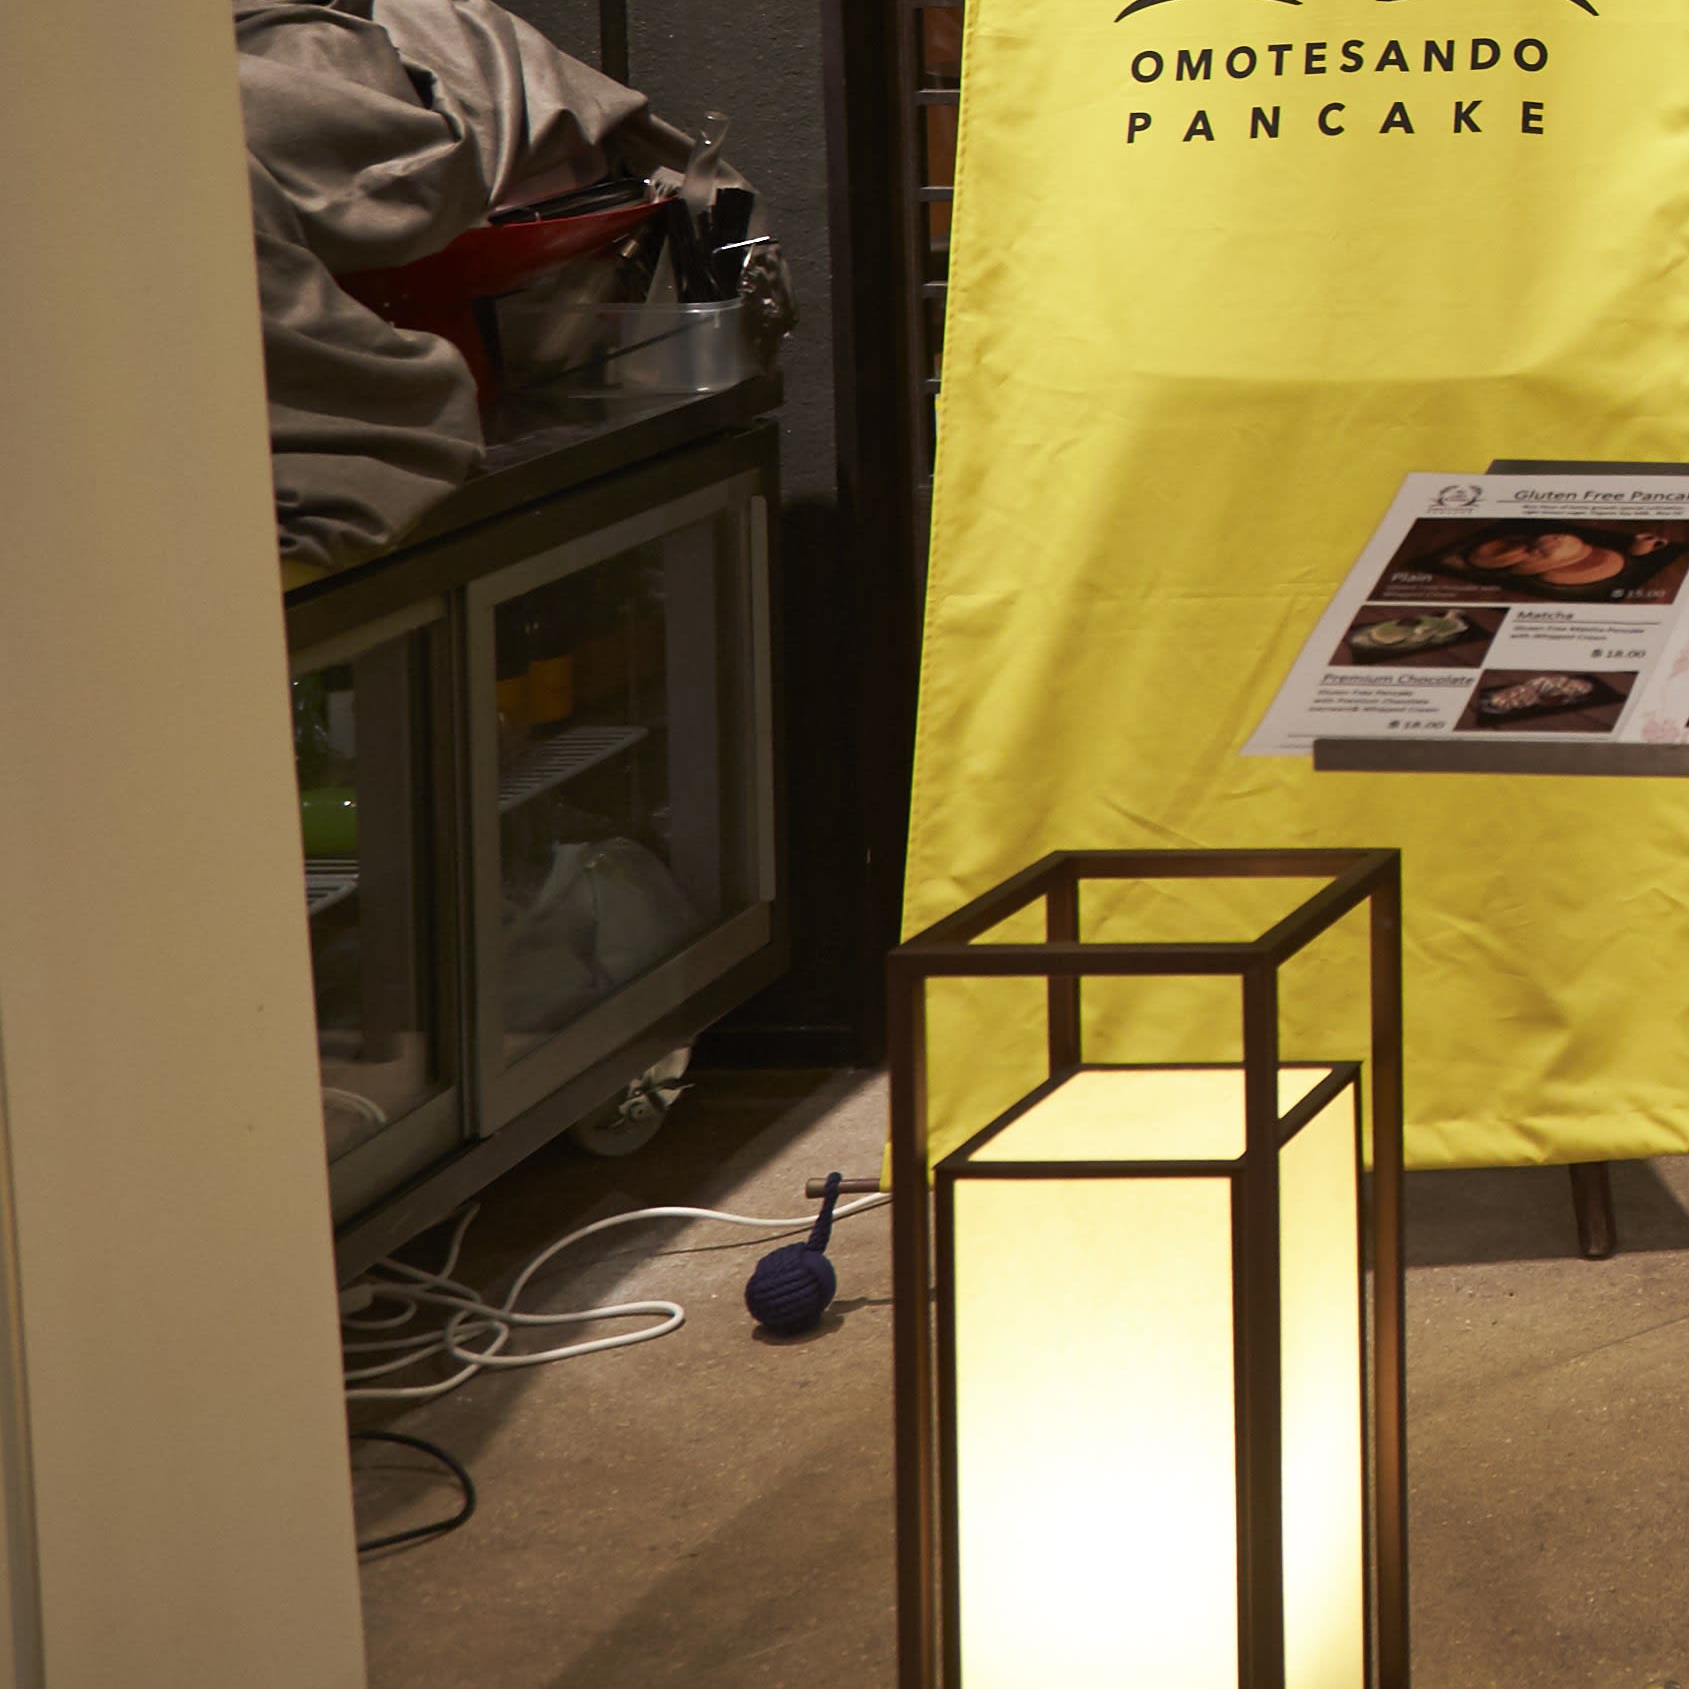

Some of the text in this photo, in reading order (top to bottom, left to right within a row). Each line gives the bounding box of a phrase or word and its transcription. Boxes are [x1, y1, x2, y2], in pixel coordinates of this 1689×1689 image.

[1129, 37, 1550, 84] OMOTESANDO
[1125, 99, 1546, 144] PANCAKE
[1514, 489, 1578, 502] Gluten
[1583, 490, 1625, 502] Free
[1390, 572, 1434, 584] Plain
[1516, 611, 1575, 622] Matcha
[1322, 673, 1475, 686] Premium Chocolate
